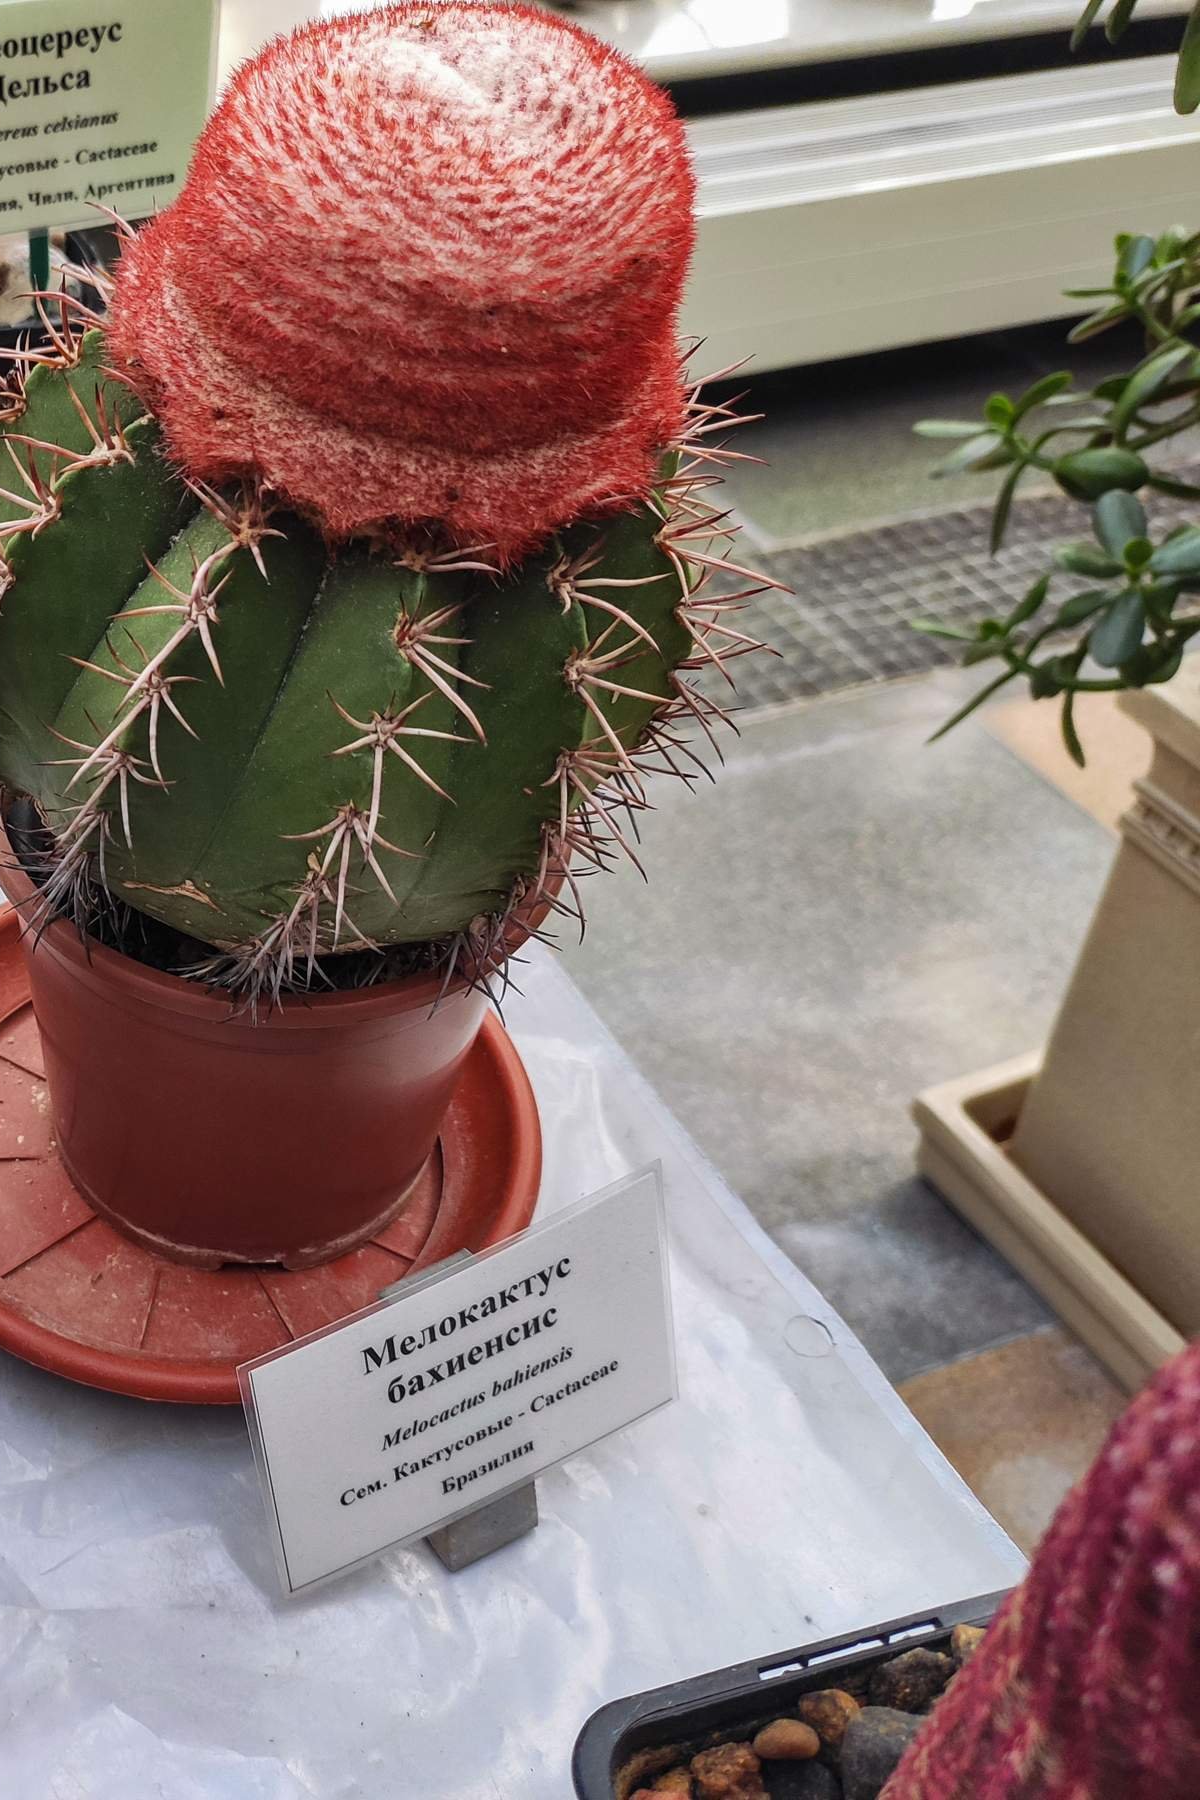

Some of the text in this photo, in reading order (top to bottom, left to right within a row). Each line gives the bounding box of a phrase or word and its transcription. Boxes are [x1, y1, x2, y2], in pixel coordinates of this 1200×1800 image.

[43, 112, 120, 135] celsianus
[75, 142, 158, 165] Cactaceae
[84, 173, 175, 199] Аргентина
[360, 1258, 571, 1375] Мелокактус
[388, 1308, 558, 1403] бахиенсис
[340, 1480, 388, 1506] Сем.
[393, 1415, 513, 1482] Кактусовые
[530, 1360, 619, 1413] Cactaceae
[382, 1346, 573, 1451] Melocactus bahiensis
[441, 1440, 534, 1495] Бразилия
